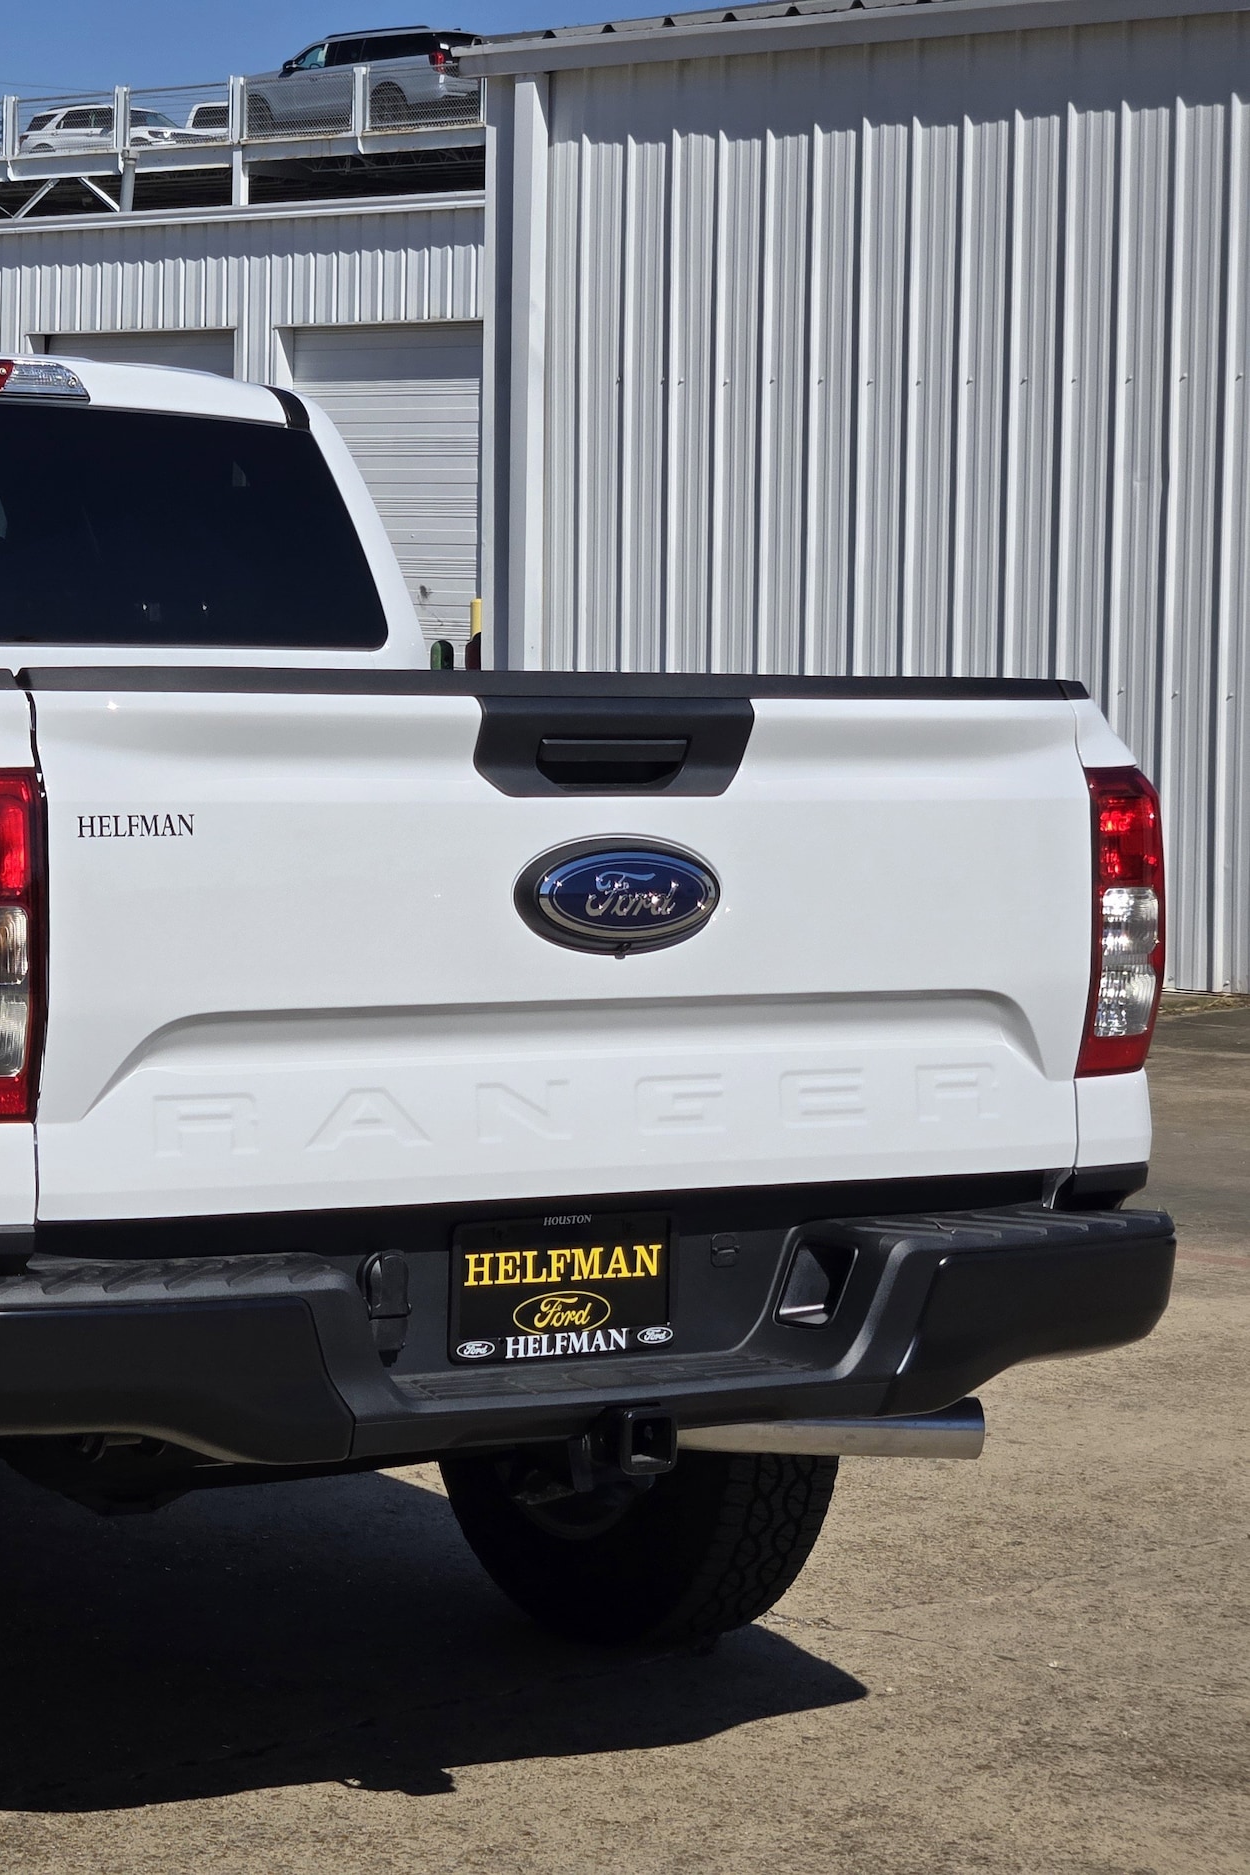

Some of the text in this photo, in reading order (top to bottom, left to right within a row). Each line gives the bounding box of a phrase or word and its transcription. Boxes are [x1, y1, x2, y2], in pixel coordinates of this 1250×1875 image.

[77, 813, 195, 838] HELFMAN
[585, 870, 680, 917] Ford
[152, 1061, 1003, 1158] RANGER
[543, 1214, 593, 1227] HOUSTON
[463, 1244, 663, 1287] HELFMAN
[533, 1295, 593, 1329] Ford
[463, 1343, 488, 1356] Ford
[504, 1328, 630, 1360] HELFMAN
[643, 1329, 668, 1341] Ford
